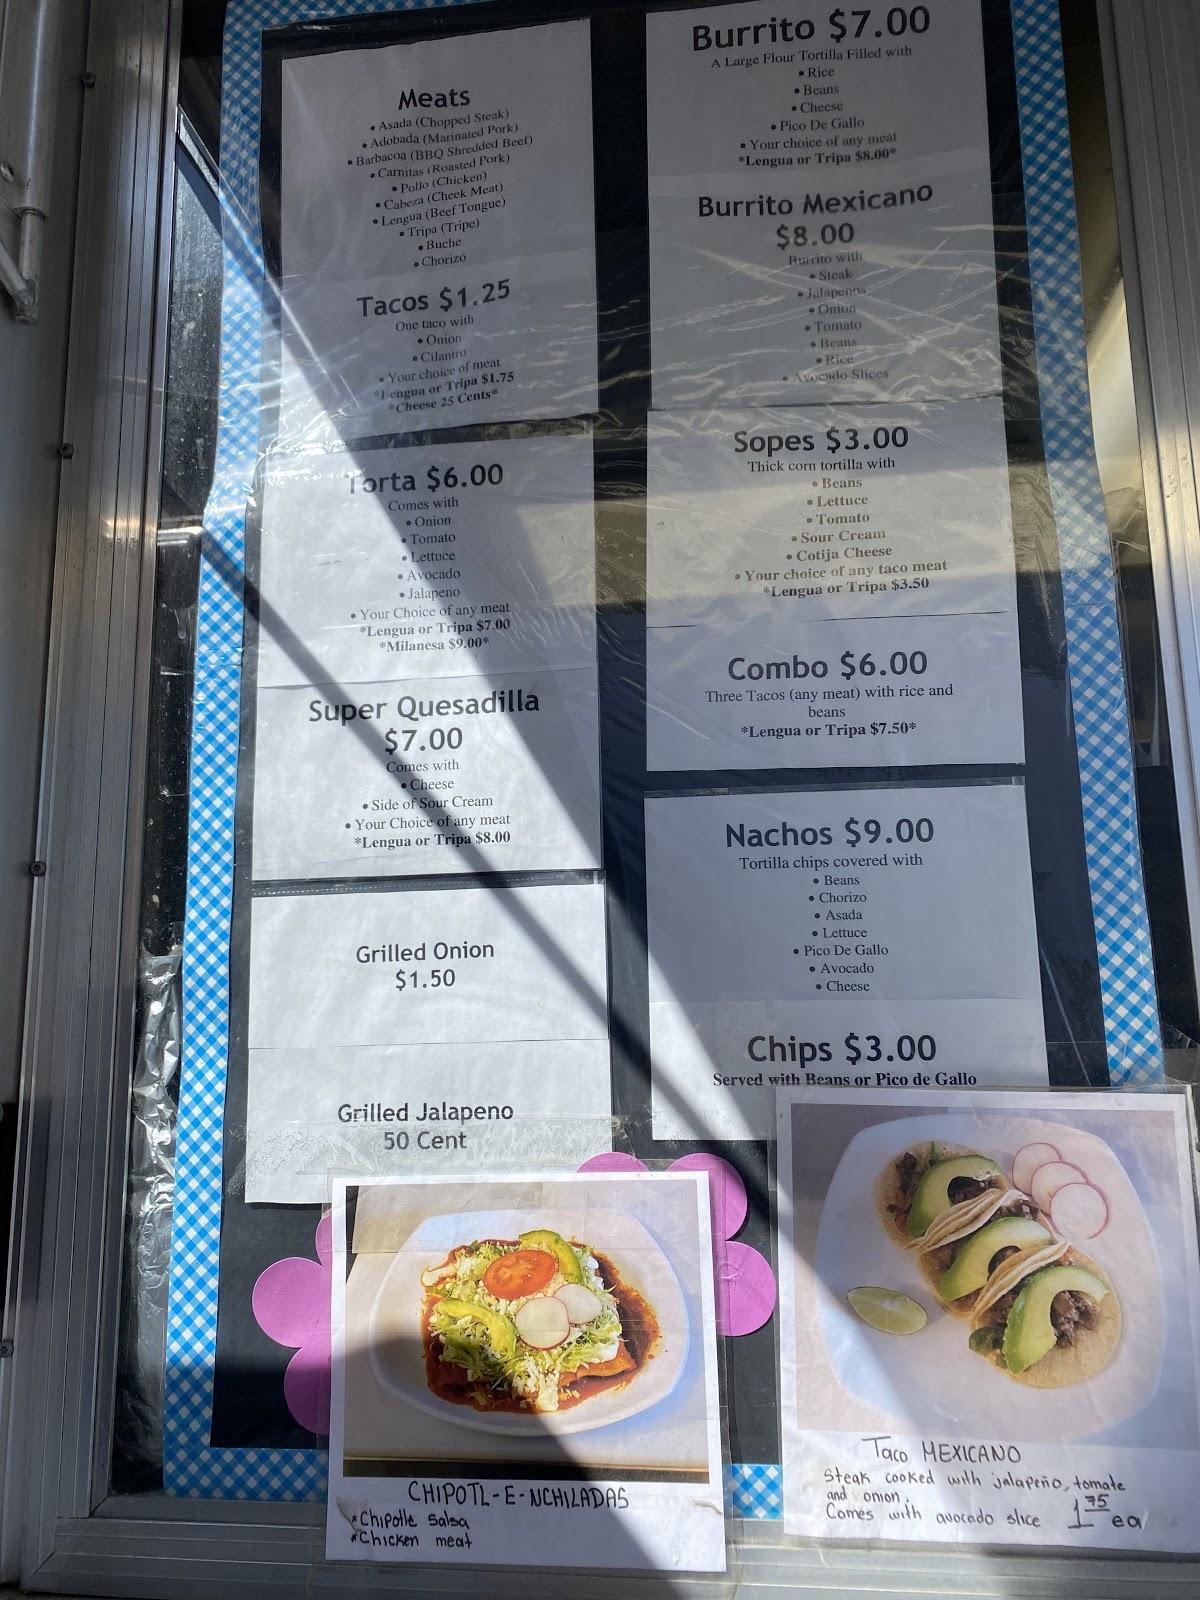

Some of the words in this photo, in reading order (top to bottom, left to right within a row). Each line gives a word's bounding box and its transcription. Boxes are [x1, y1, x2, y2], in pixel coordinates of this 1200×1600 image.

[692, 16, 815, 51] Burrito
[829, 5, 930, 43] $7.00
[808, 67, 835, 78] Rice
[803, 84, 839, 96] Beans
[399, 88, 470, 110] Meats
[800, 101, 844, 113] Cheese
[379, 118, 412, 130] Asada
[416, 115, 471, 130] (Chopped
[474, 109, 509, 123] Steak)
[780, 120, 806, 131] Pico
[811, 119, 828, 130] De
[831, 117, 864, 129] Gallo
[370, 133, 419, 149] Adobada
[423, 128, 484, 146] (Marinated
[488, 123, 518, 135] Pork)
[378, 167, 424, 178] Carnitas
[427, 159, 476, 176] (Roasted
[479, 154, 510, 167] Pork)
[401, 181, 429, 193] Pollo
[432, 172, 487, 188] (Chicken)
[384, 197, 424, 210] Cabeza
[427, 189, 466, 204] (Cheek
[470, 183, 503, 196] Meat)
[699, 195, 793, 217] Burrito
[803, 184, 933, 215] Mexicano
[382, 211, 422, 226] Lengua
[425, 206, 456, 222] (Beef
[460, 197, 506, 214] Tongue)
[408, 226, 437, 238] Tripa
[441, 218, 480, 234] (Tripe)
[776, 222, 855, 250] $8.00
[426, 238, 461, 249] Buche
[421, 253, 467, 267] Chorizo
[819, 270, 852, 281] Steak
[357, 291, 429, 317] Tacos
[439, 279, 511, 312] $1.25
[395, 321, 419, 332] One
[422, 318, 446, 328] taco
[450, 315, 474, 326] with
[814, 320, 862, 332] Tomato
[426, 334, 462, 345] Onion
[734, 430, 815, 457] Sopes
[826, 426, 909, 454] $3.00
[748, 460, 784, 473] Thick
[788, 461, 817, 471] corn
[820, 459, 863, 470] tortilla
[867, 457, 895, 469] with
[427, 464, 504, 492] $6.00
[822, 478, 862, 489] Beans
[388, 499, 429, 511] Comes
[433, 497, 459, 508] with
[817, 495, 869, 507] Lettuce
[415, 515, 451, 527] Onion
[816, 513, 870, 525] Tomato
[410, 532, 456, 544] Tomato
[801, 532, 835, 544] Sour
[838, 529, 886, 541] Cream
[411, 550, 456, 563] Lettuce
[796, 549, 839, 562] Cotija
[844, 546, 893, 557] Cheese
[827, 584, 842, 594] or
[847, 581, 887, 594] Tripa
[891, 577, 929, 591] $3.50
[728, 655, 828, 680] Combo
[840, 650, 928, 680] $6.00
[705, 690, 742, 702] Three
[746, 690, 785, 701] Tacos
[789, 689, 817, 701] (any
[823, 685, 860, 700] meat)
[864, 685, 894, 697] with
[899, 685, 925, 696] rice
[929, 684, 954, 696] and
[309, 700, 387, 726] Super
[398, 689, 540, 721] Quesadilla
[808, 705, 846, 718] beans
[805, 726, 821, 736] or
[825, 724, 866, 738] Tripa
[385, 727, 463, 755] $7.00
[386, 761, 429, 773] Comes
[432, 759, 459, 770] with
[410, 778, 454, 790] Cheese
[372, 799, 399, 811] Side
[403, 798, 417, 809] of
[419, 797, 448, 808] Sour
[452, 795, 493, 807] Cream
[355, 818, 385, 831] Your
[389, 816, 434, 828] Choice
[437, 815, 451, 826] of
[454, 816, 476, 828] any
[480, 814, 510, 824] meat
[415, 836, 430, 846] or
[434, 833, 471, 846] Tripa
[475, 831, 511, 844] $8.00
[726, 822, 833, 848] Nachos
[845, 817, 934, 848] $9.00
[739, 856, 789, 870] Tortilla
[793, 856, 829, 871] chips
[833, 854, 887, 867] covered
[892, 853, 923, 866] with
[824, 875, 860, 886] Beans
[819, 891, 867, 903] Chorizo
[826, 909, 863, 920] Asada
[823, 927, 868, 938] Lettuce
[356, 943, 426, 963] Grilled
[433, 941, 494, 960] Onion
[804, 945, 831, 956] Pico
[834, 944, 851, 956] De
[855, 944, 889, 956] Gallo
[821, 963, 874, 974] Avocado
[395, 969, 455, 991] $1.50
[826, 980, 870, 992] Cheese
[748, 1035, 833, 1068] Chips
[844, 1032, 937, 1066] $3.00
[713, 1073, 763, 1087] Served
[768, 1073, 800, 1086] with
[806, 1073, 850, 1086] Beans
[854, 1075, 871, 1086] or
[876, 1073, 908, 1086] Pico
[912, 1073, 931, 1086] de
[935, 1073, 977, 1086] Gallo
[338, 1103, 408, 1123] Grilled
[416, 1102, 514, 1125] Jalapeno
[384, 1131, 409, 1150] 50
[417, 1131, 467, 1150] Cent
[862, 1436, 908, 1463] Taco
[921, 1441, 1022, 1464] MEXICANO
[885, 1471, 935, 1486] cooked
[948, 1474, 981, 1487] with
[826, 1488, 848, 1501] and
[826, 1504, 874, 1521] Comes
[889, 1505, 922, 1521] with
[936, 1509, 994, 1527] avocado
[1007, 1510, 1041, 1528] slice
[1112, 1515, 1142, 1530] ea
[436, 1531, 473, 1548] meat
